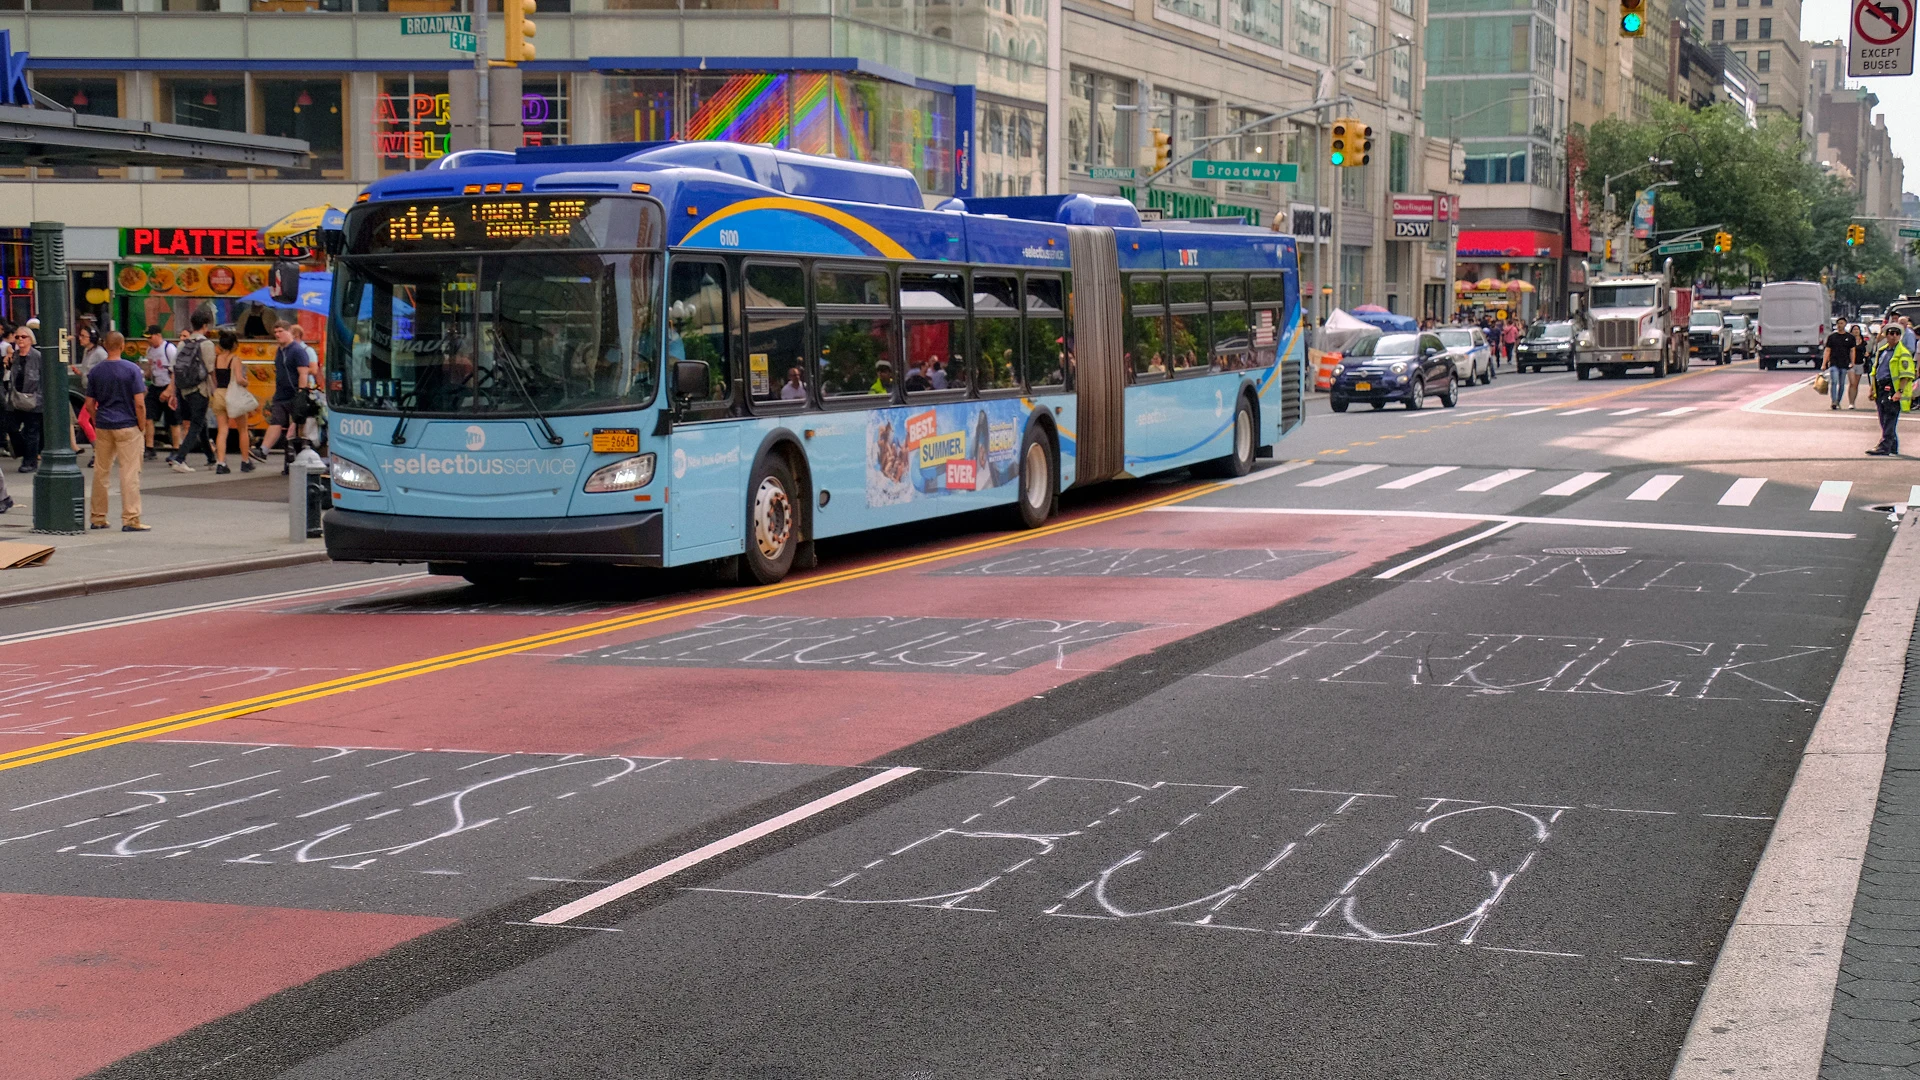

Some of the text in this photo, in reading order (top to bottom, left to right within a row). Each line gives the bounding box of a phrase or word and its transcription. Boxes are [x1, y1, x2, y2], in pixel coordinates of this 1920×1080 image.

[406, 16, 467, 34] BROADWAY
[452, 32, 459, 49] E
[459, 34, 468, 50] 14
[1861, 48, 1901, 58] EXCEPT
[1863, 60, 1898, 70] BUSES
[371, 93, 399, 124] A
[1092, 169, 1133, 179] BROADWAY
[1207, 164, 1281, 181] Broadway
[719, 229, 739, 246] 6100
[1397, 222, 1429, 236] DSW
[340, 419, 373, 436] 6100
[909, 417, 935, 442] BEST.
[922, 437, 964, 463] SUMMER.
[947, 464, 976, 484] EVER.
